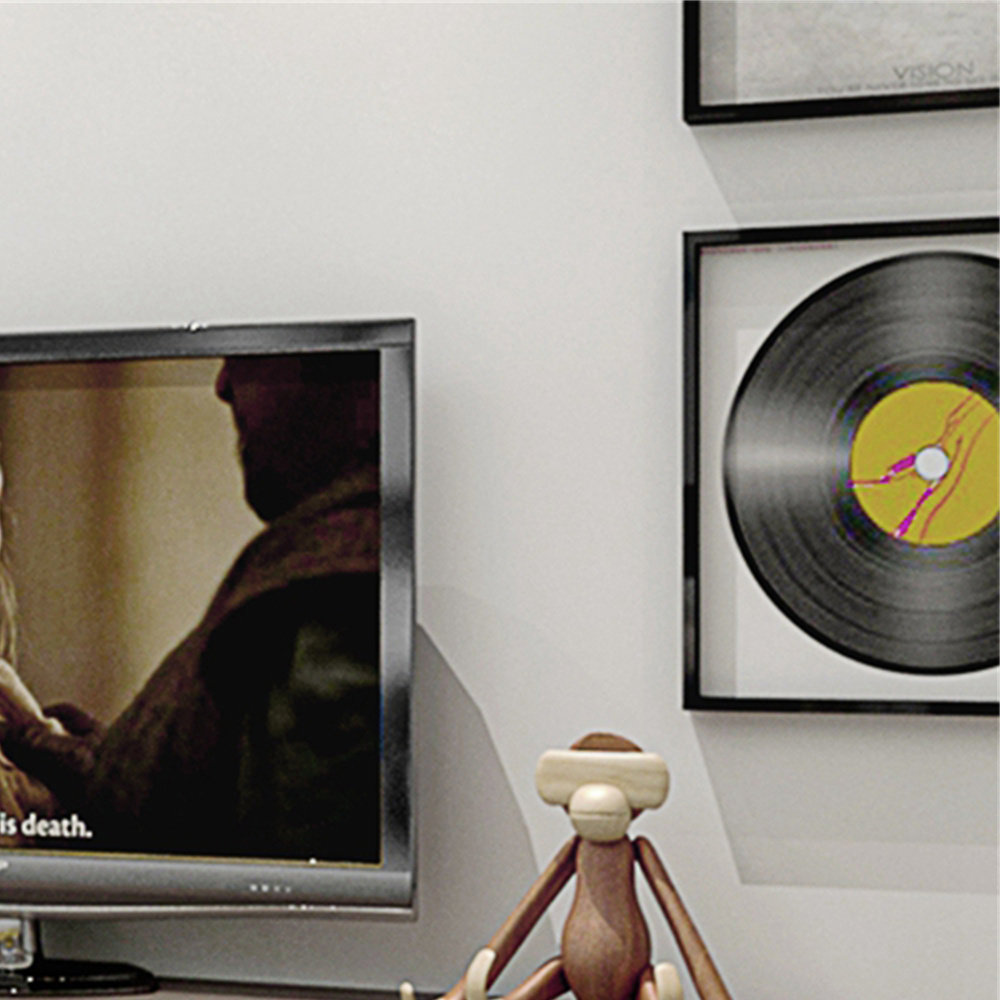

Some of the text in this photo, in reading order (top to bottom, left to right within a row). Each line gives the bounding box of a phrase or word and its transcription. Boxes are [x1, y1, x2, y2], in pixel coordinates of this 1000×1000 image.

[892, 60, 975, 80] VISION
[0, 812, 16, 836] is
[21, 813, 93, 838] death.
